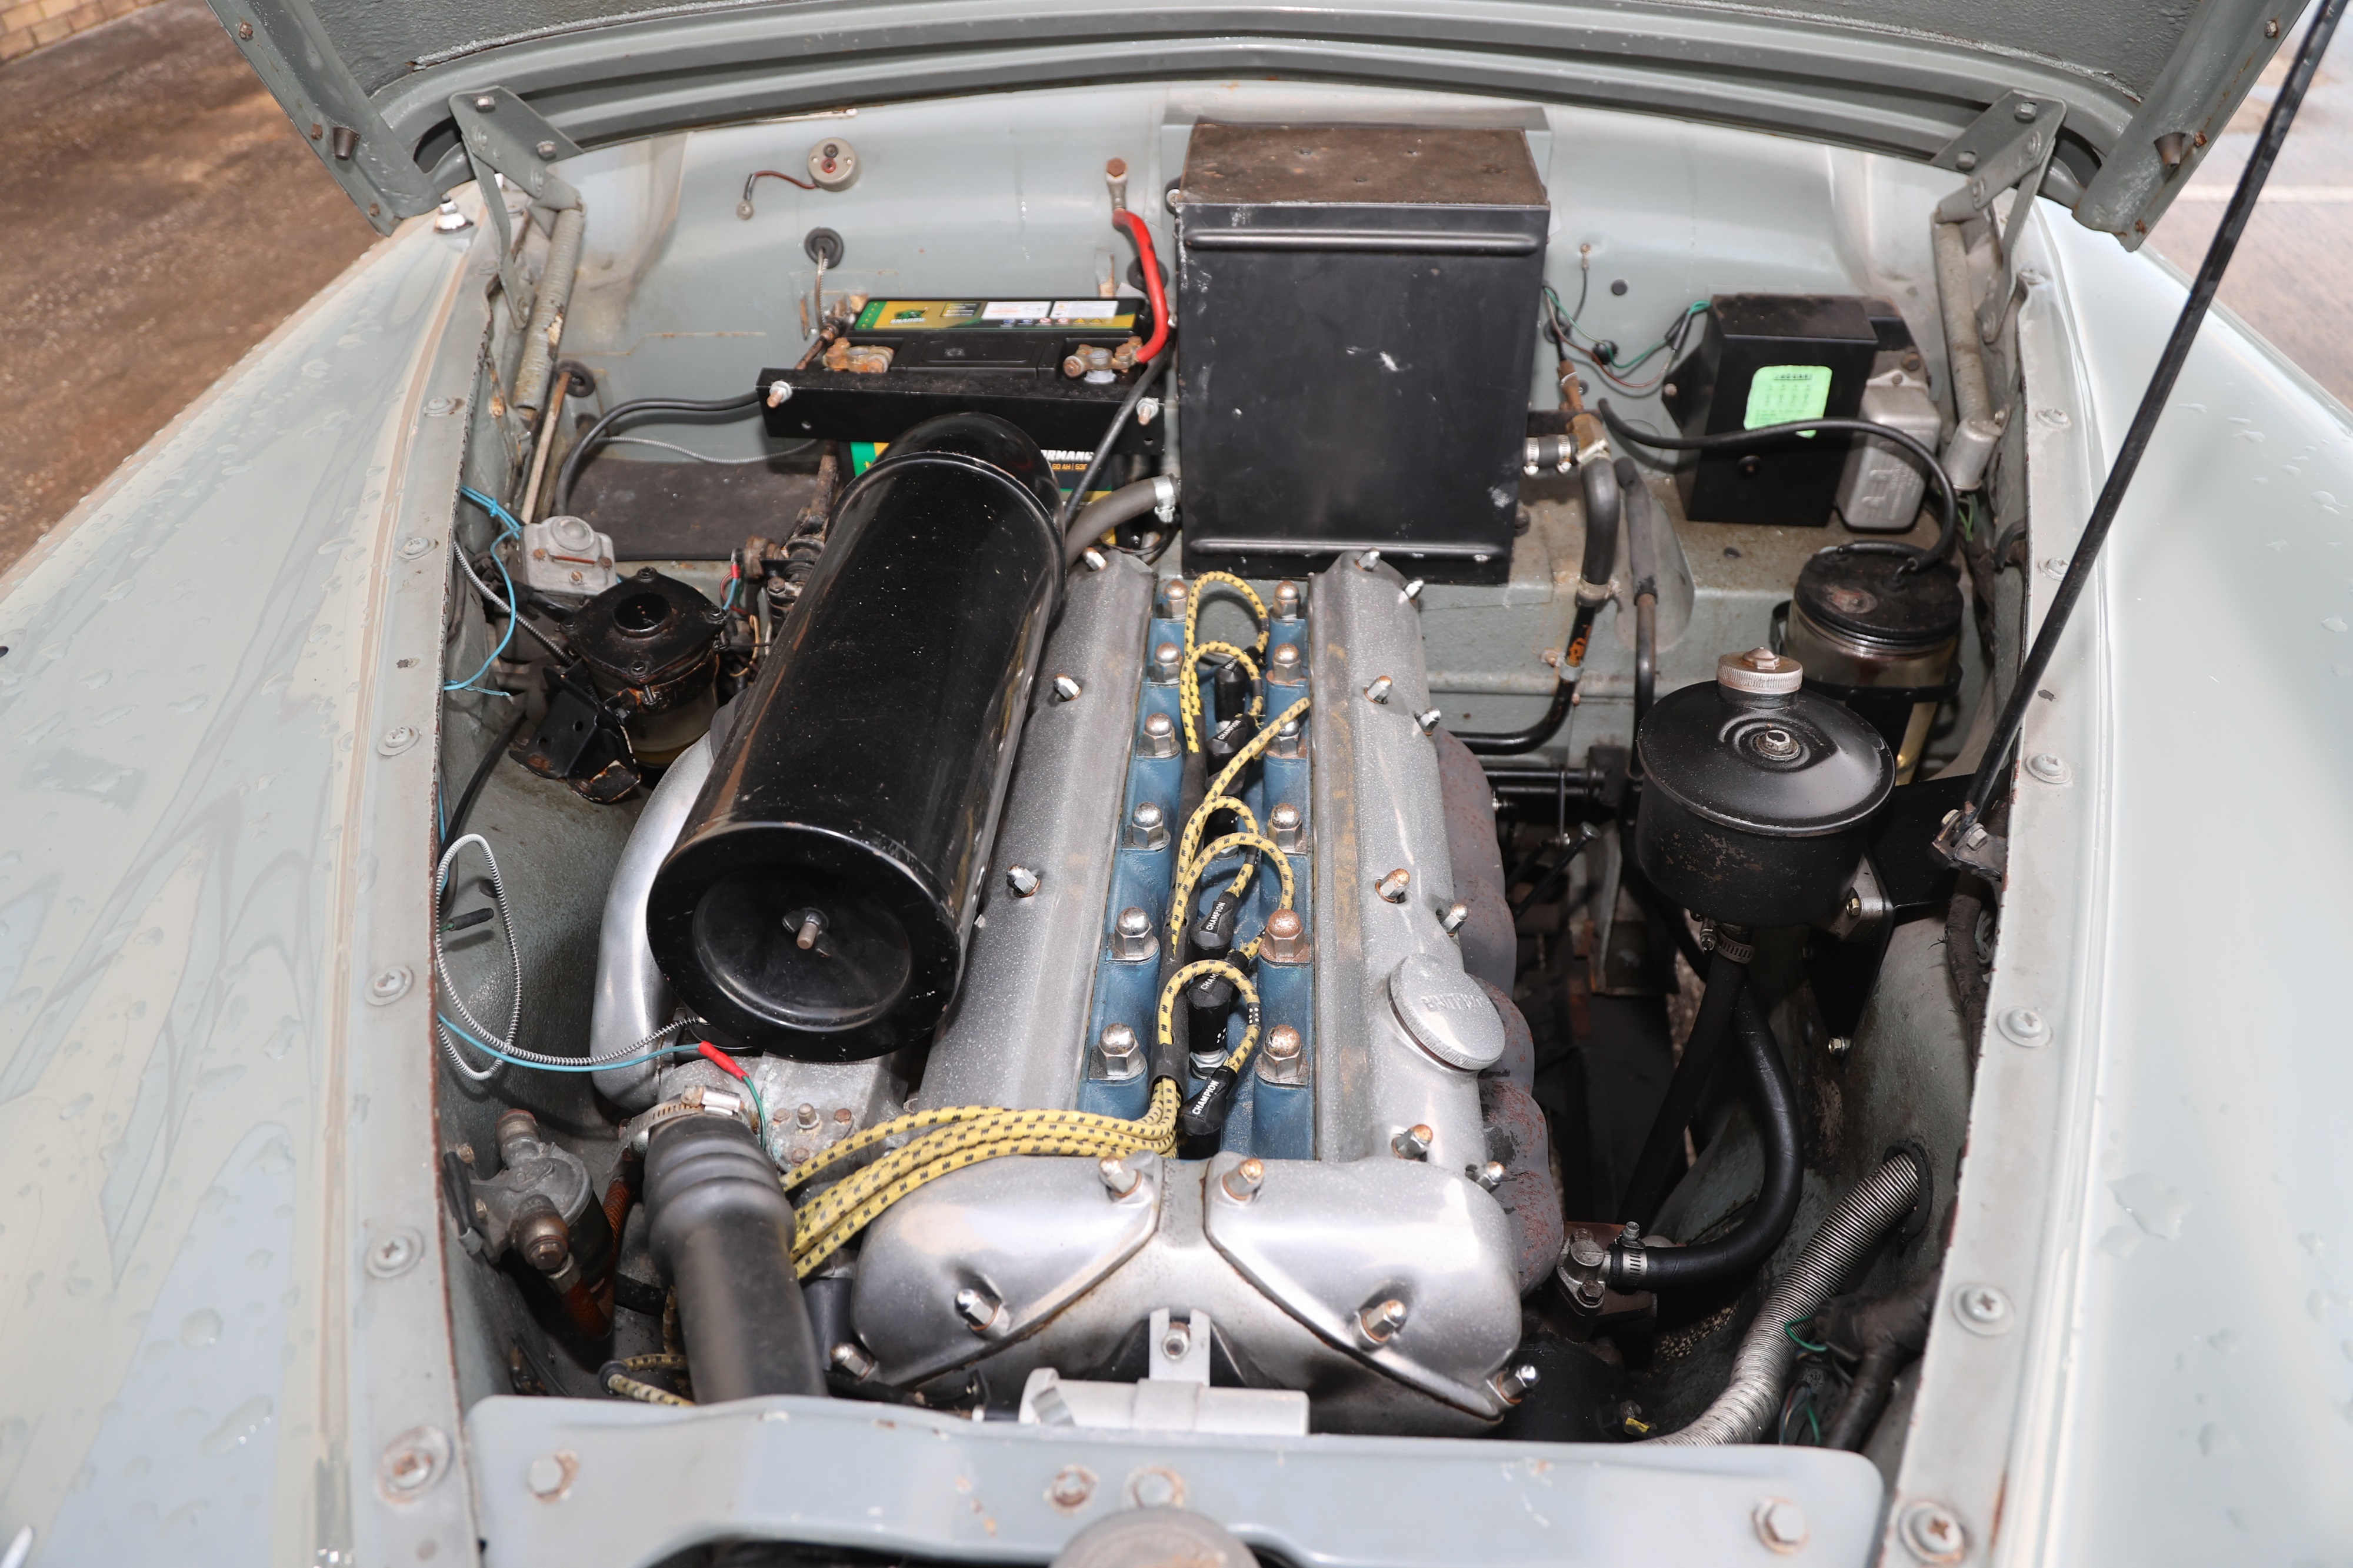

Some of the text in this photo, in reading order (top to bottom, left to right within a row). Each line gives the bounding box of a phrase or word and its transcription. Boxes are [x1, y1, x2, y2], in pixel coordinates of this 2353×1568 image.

[1040, 449, 1095, 462] RMANC
[1224, 658, 1238, 670] CHAM
[1218, 719, 1241, 740] CHAMPION
[1206, 902, 1226, 930] CHAMPION
[1200, 973, 1219, 990] CHAM
[1192, 1080, 1219, 1115] CHAMPION
